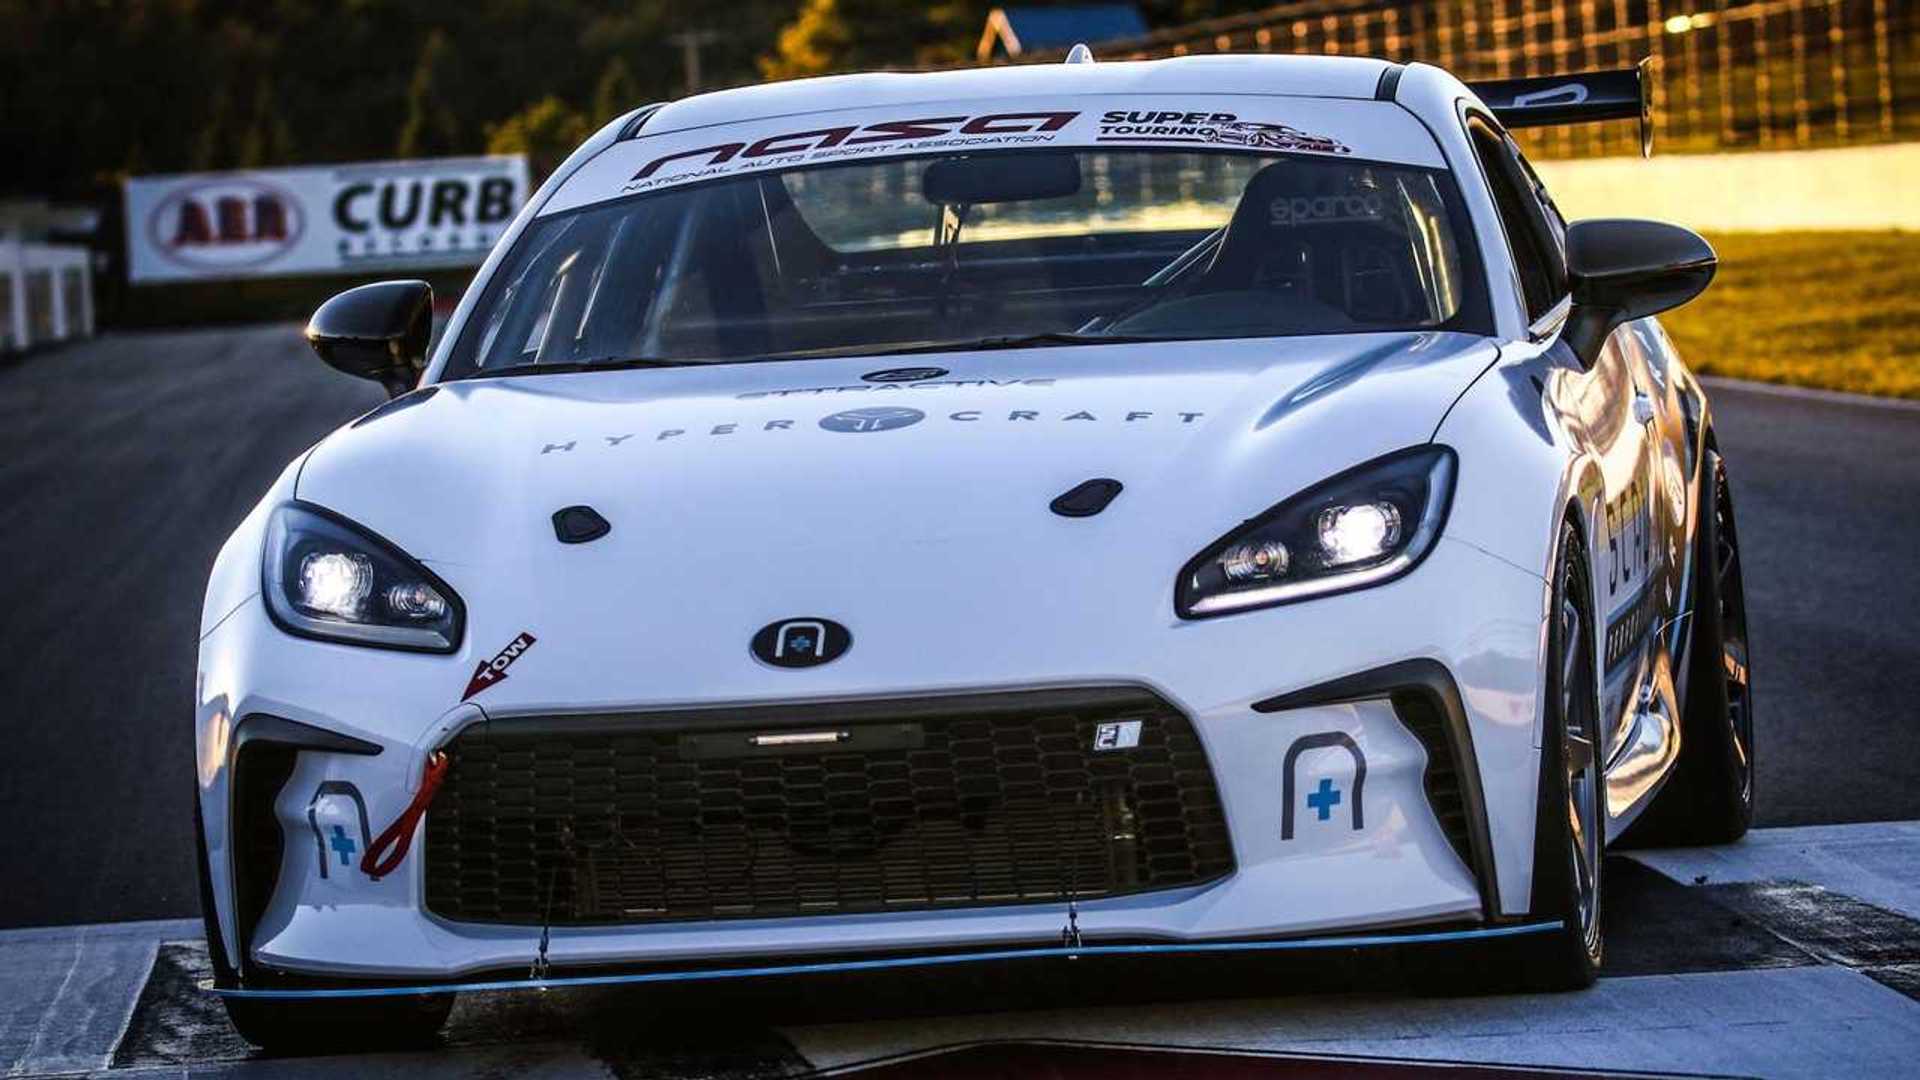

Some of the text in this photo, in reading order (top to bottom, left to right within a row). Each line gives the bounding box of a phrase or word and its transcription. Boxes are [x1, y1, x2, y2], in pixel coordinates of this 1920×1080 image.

[1099, 126, 1219, 136] TOURING
[1100, 111, 1238, 124] SUPER
[621, 134, 1056, 192] NATIONAL AUTO SPORT ASSOCIATION
[332, 176, 516, 234] CURB
[477, 637, 528, 681] TOW
